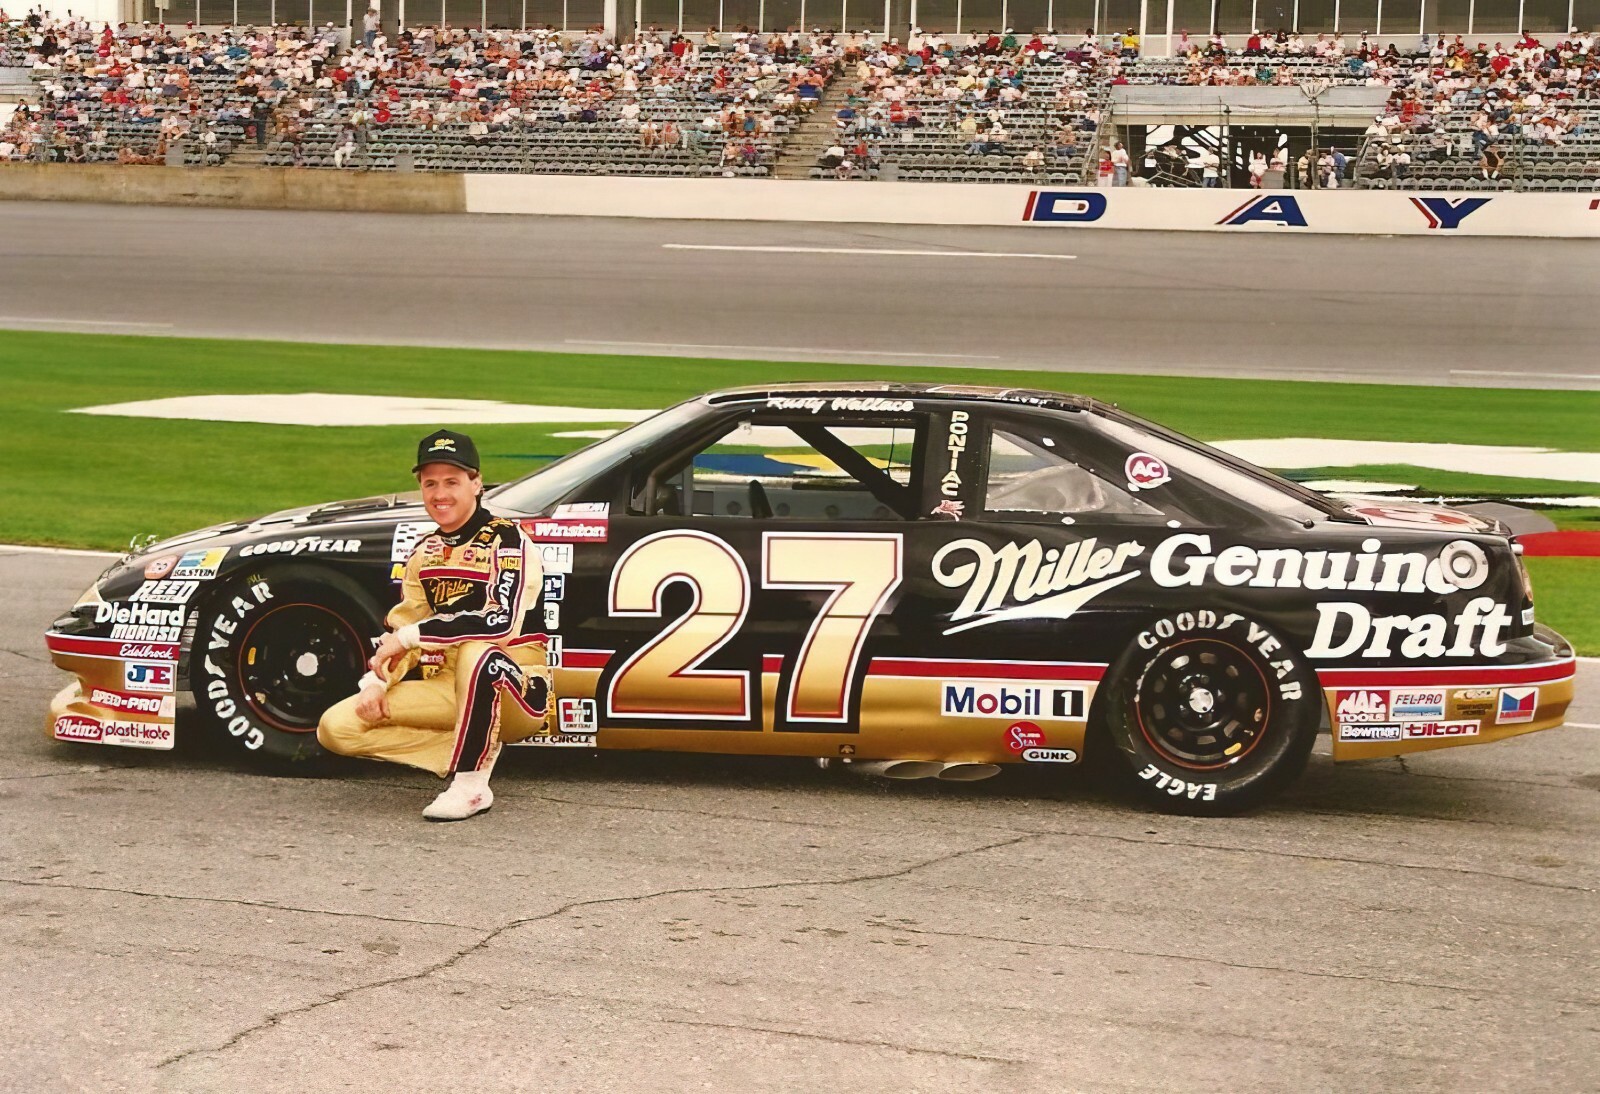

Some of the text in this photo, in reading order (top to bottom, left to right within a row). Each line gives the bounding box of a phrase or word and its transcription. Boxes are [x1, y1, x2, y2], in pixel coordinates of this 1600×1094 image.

[831, 397, 914, 411] Wallace
[941, 411, 970, 496] PONTIAC
[1131, 460, 1162, 479] AC
[535, 523, 607, 538] Winston
[239, 536, 362, 557] GOODYEAR
[542, 546, 569, 563] CH
[931, 537, 1146, 622] Miller
[128, 580, 200, 603] REED
[94, 602, 186, 627] DieHard
[607, 529, 903, 723] 27
[1303, 597, 1513, 658] Draft
[120, 644, 174, 660] Edelbrock
[127, 664, 171, 685] JE
[91, 689, 160, 712] SPEED-PRO
[945, 686, 1040, 716] Mobil
[1336, 690, 1387, 713] MAC
[1395, 693, 1443, 705] FEL-PRO
[1337, 712, 1386, 722] TOOLS
[55, 718, 101, 738] Heinz
[105, 721, 171, 741] plasti-kote
[1340, 724, 1401, 739] Bowman
[1404, 722, 1478, 737] tilton
[1028, 750, 1071, 762] GUNK
[1138, 763, 1218, 801] EAGLE
